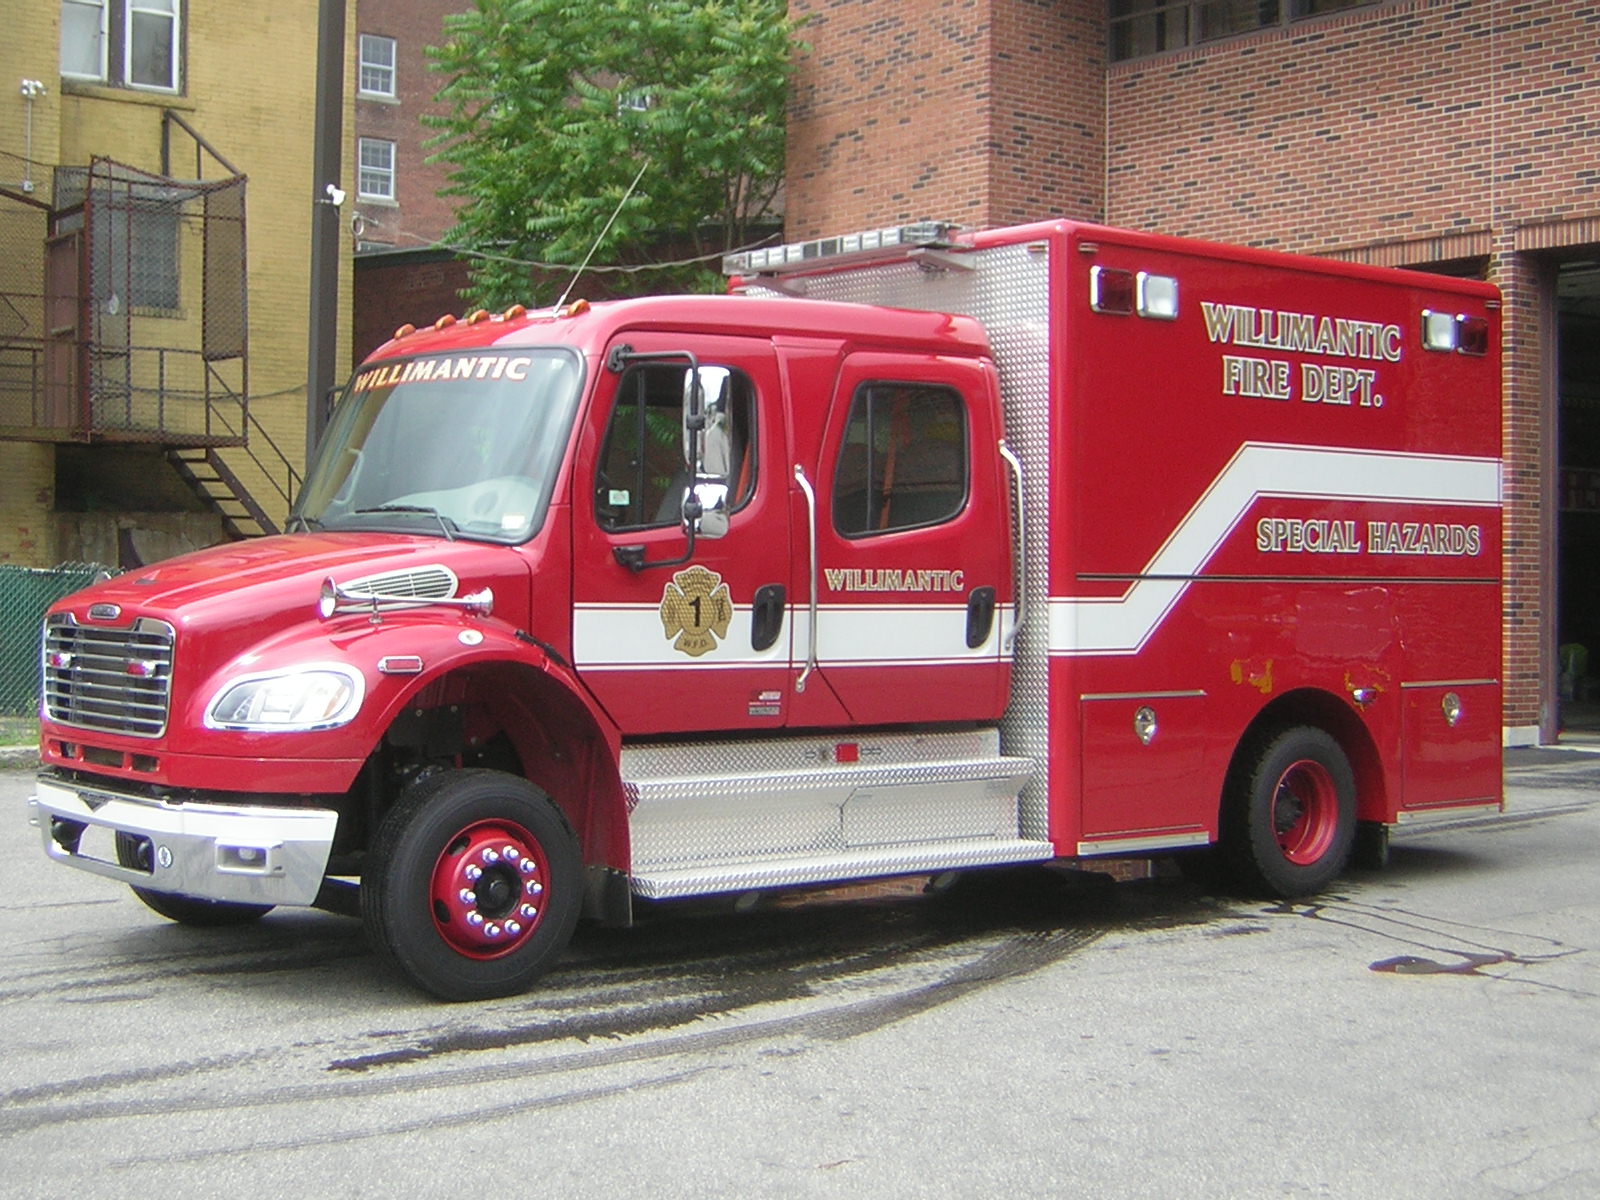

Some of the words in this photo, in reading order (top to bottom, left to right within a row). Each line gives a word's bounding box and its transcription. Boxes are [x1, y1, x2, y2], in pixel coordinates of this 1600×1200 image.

[1200, 301, 1402, 362] WILLIMANTIC
[353, 357, 532, 393] WILLIMANTIC
[1222, 355, 1291, 399] FIRE
[1301, 363, 1383, 408] DEPT.
[1256, 518, 1361, 553] SPECIAL
[1367, 521, 1480, 556] HAZARDS
[824, 568, 965, 592] WILLIMANTIC
[689, 596, 700, 627] 1
